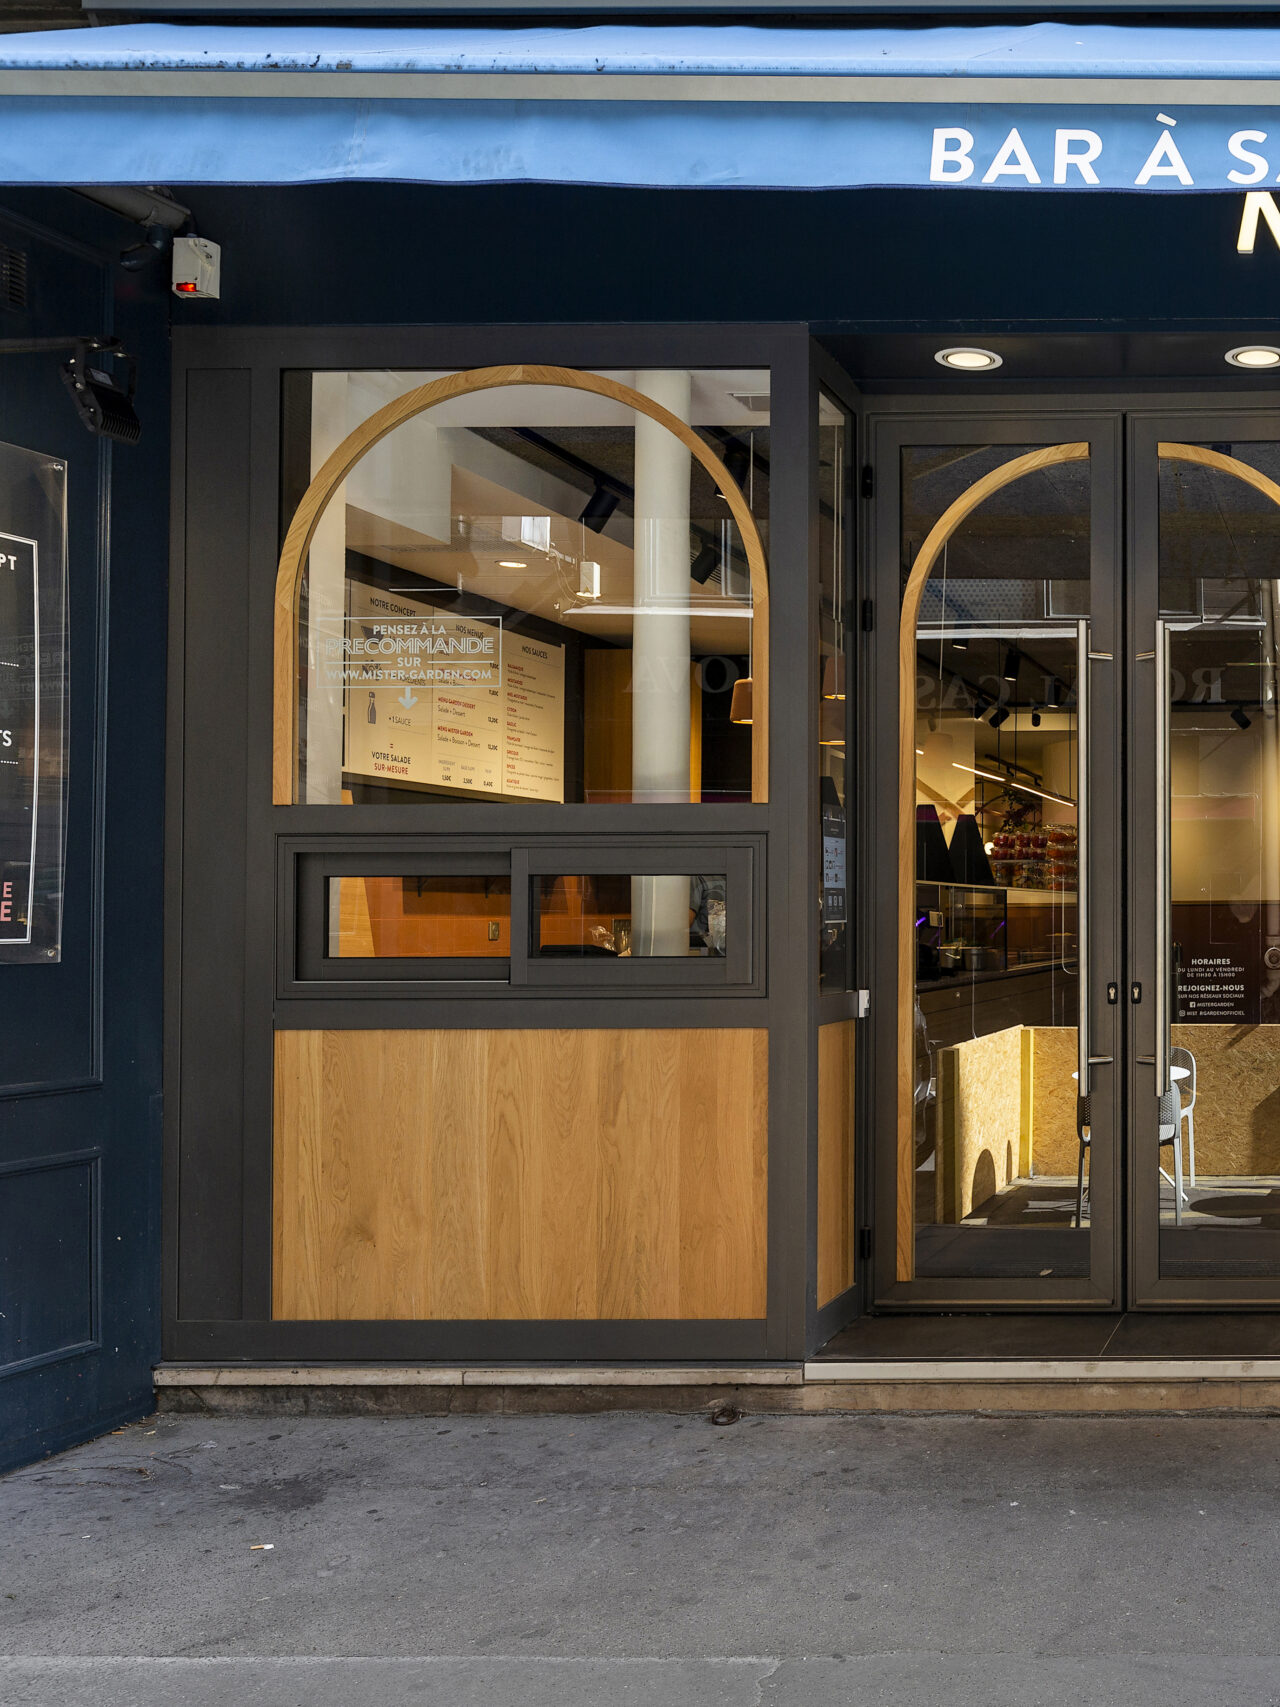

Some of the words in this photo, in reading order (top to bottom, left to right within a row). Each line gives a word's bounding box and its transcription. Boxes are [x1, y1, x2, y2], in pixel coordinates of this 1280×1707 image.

[928, 127, 1104, 185] BAR
[1134, 112, 1195, 185] À
[373, 624, 418, 635] PENSEZ
[420, 621, 429, 635] À
[431, 624, 447, 635] LA
[326, 637, 494, 655] PRECOMMANDE
[397, 657, 421, 667] SUR
[327, 669, 492, 680] WWW.MISTER-GARDEN.COM
[395, 716, 412, 726] SAUCE
[371, 751, 390, 761] VOTRE
[391, 754, 411, 765] SALADE
[374, 762, 409, 775] SUR-MESURE
